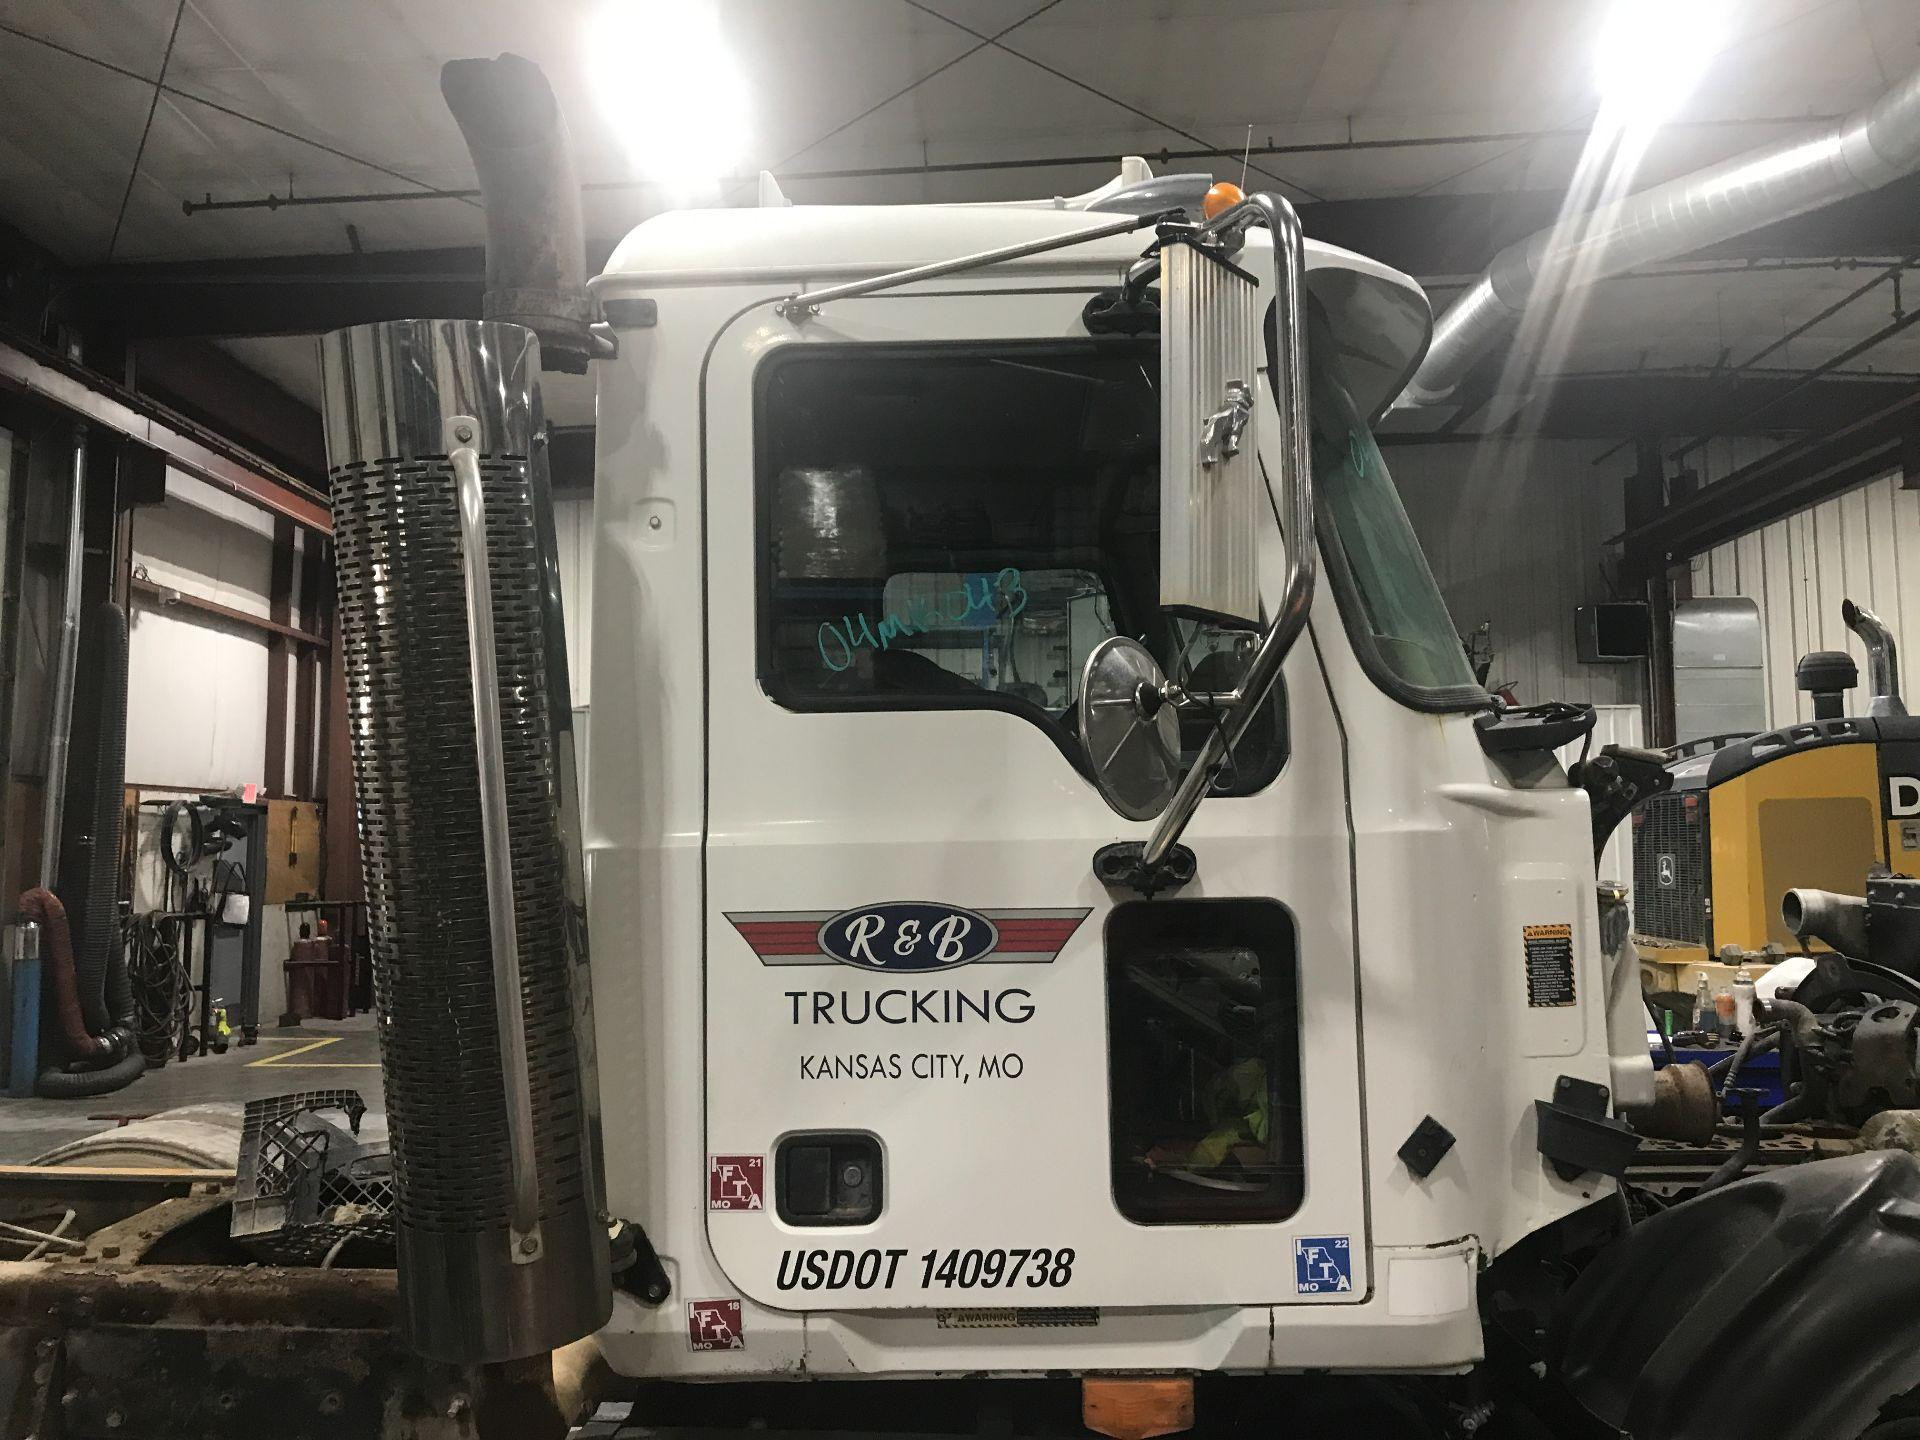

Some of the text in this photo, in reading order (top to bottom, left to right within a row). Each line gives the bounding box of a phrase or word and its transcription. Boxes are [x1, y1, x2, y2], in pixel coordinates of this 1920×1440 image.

[1534, 928, 1568, 937] WARNING
[785, 988, 1035, 1024] TRUCKING
[800, 1053, 1024, 1084] KANSAS CITY, MO
[748, 1158, 761, 1167] 21
[711, 1200, 731, 1209] MO
[1334, 1240, 1349, 1249] 22
[777, 1248, 1075, 1290] USDOT 1409738
[1299, 1282, 1319, 1292] MO
[965, 1312, 1016, 1322] WARNING
[693, 1342, 713, 1350] MO
